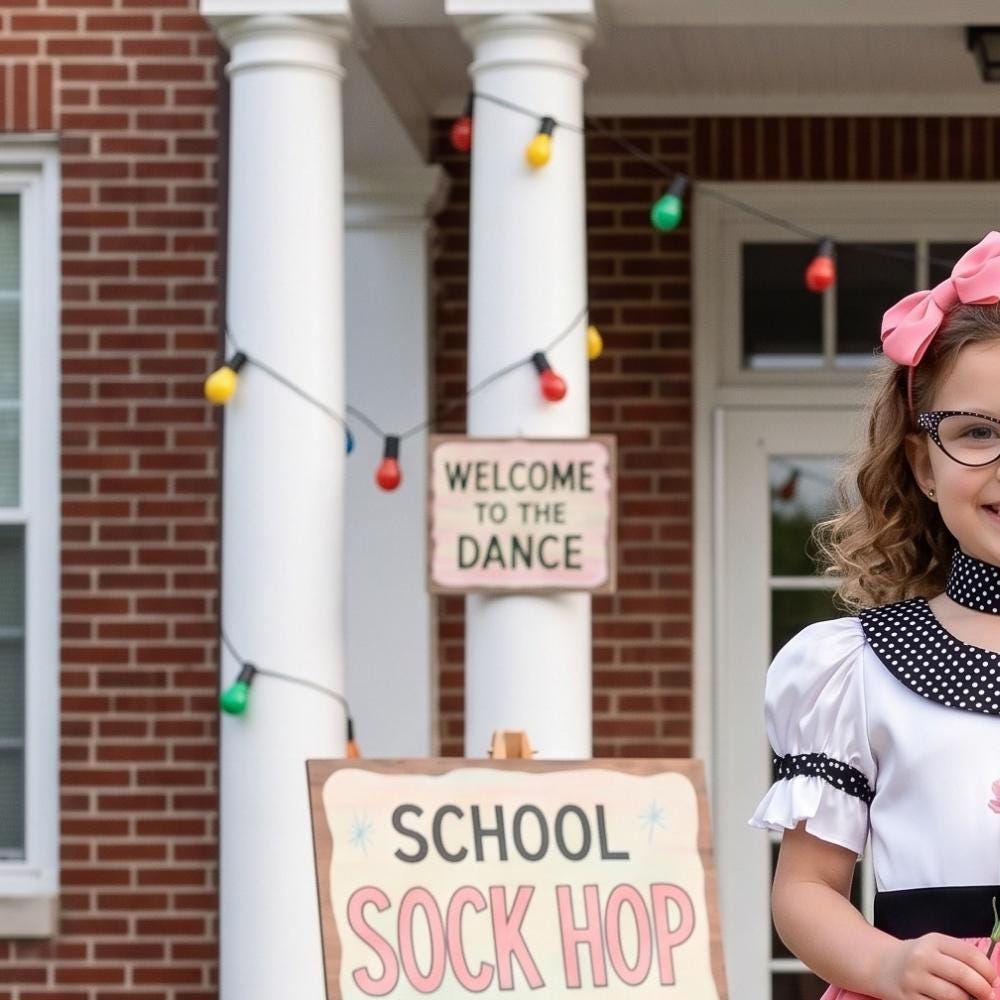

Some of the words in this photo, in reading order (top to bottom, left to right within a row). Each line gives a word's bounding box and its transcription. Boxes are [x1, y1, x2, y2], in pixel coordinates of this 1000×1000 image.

[445, 461, 594, 492] WELCOME
[475, 502, 507, 524] TO
[518, 502, 566, 524] THE
[457, 534, 583, 570] DANCE
[391, 804, 630, 863] SCHOOL
[346, 885, 546, 997] SOCK
[555, 883, 696, 989] HOP
